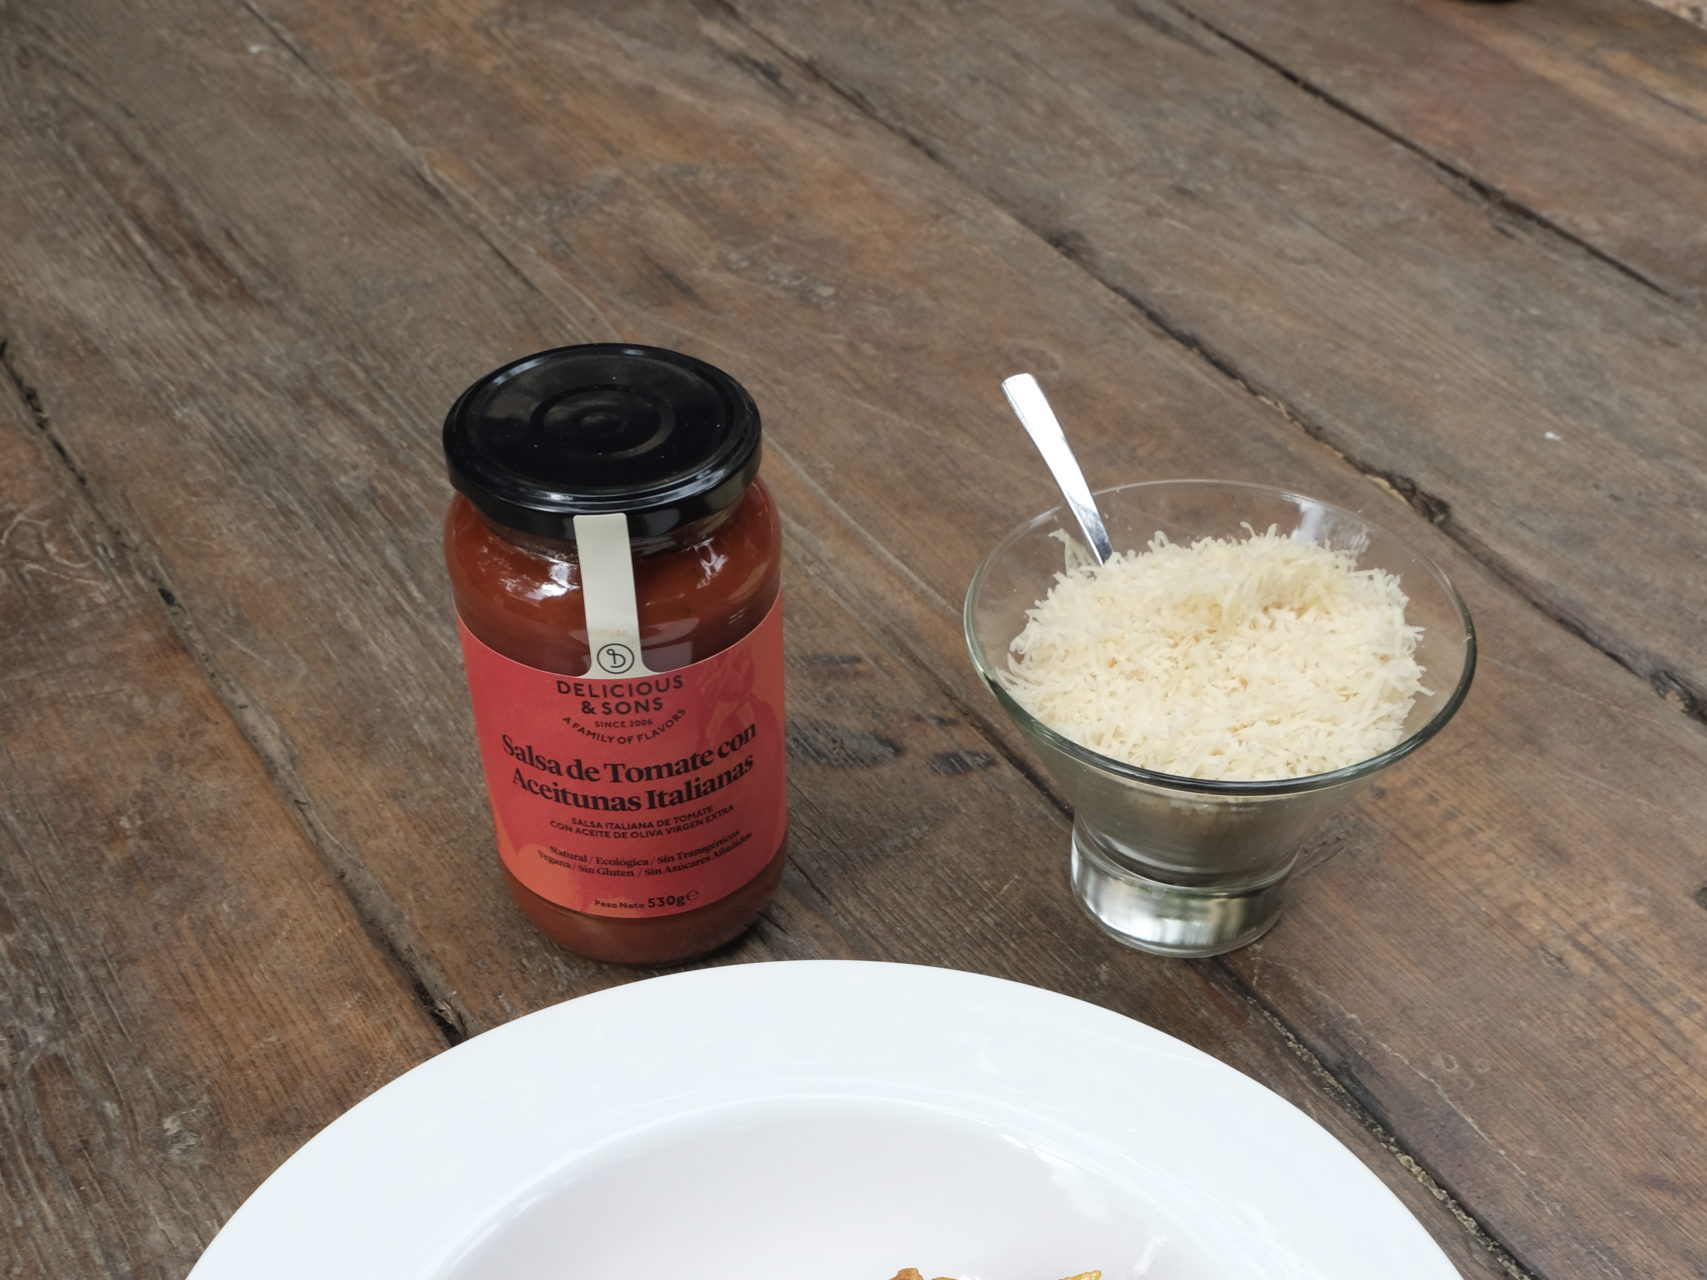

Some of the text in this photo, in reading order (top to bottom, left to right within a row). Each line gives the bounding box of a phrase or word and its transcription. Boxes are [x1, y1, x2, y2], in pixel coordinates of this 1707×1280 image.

[557, 674, 684, 698] DELICIOUS
[581, 697, 663, 715] & SONS
[572, 722, 615, 743] FAMILY
[617, 736, 633, 744] OF
[637, 708, 686, 742] FLAVORS
[502, 723, 757, 783] Salsa de Tomate con
[513, 754, 753, 812] Aceitunas Italianas
[550, 821, 572, 832] CON
[575, 828, 611, 838] ACEITE
[630, 829, 663, 838] OLIVA
[665, 819, 704, 834] VIRGEN
[706, 804, 734, 823] EXTRA
[572, 805, 713, 830] SALSA ITALIANA DE TOMATE
[538, 849, 571, 869] Vegana
[578, 864, 595, 874] Sin
[597, 866, 634, 877] Gluten
[644, 866, 661, 875] Sin
[550, 845, 588, 863] Natural
[657, 855, 674, 863] Sin
[594, 899, 618, 908] Peso
